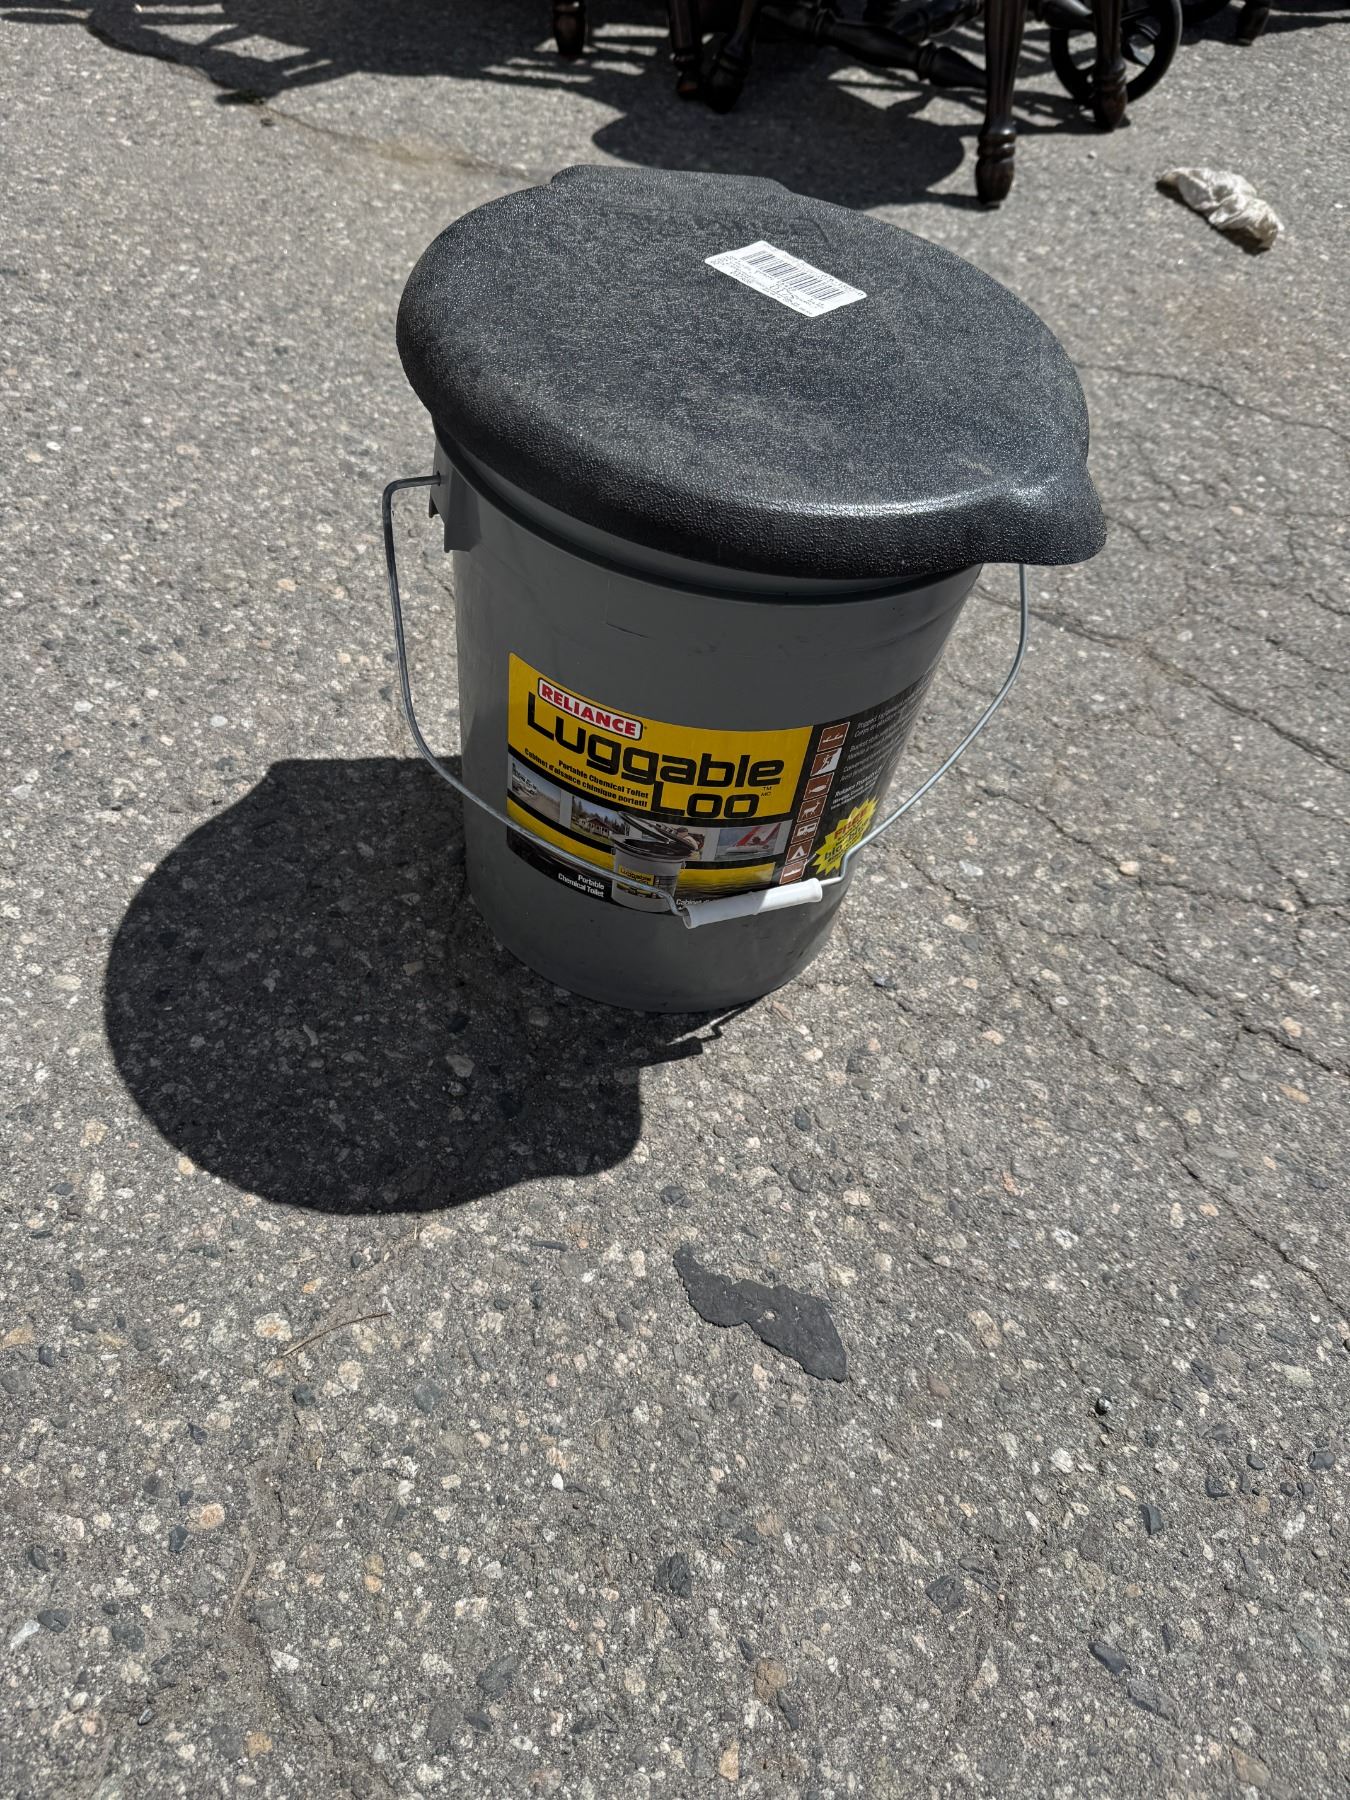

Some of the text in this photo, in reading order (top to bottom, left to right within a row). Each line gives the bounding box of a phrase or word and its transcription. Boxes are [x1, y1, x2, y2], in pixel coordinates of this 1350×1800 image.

[541, 683, 637, 736] RELIANCE
[527, 691, 785, 788] Luggable
[524, 747, 548, 769] Cabinet
[582, 781, 617, 800] chimique
[618, 794, 648, 808] portatif
[559, 760, 649, 799] Portable Chemical Toilet
[651, 780, 760, 818] Loo
[558, 873, 604, 898] Chemical Toilet
[578, 874, 605, 890] Portable
